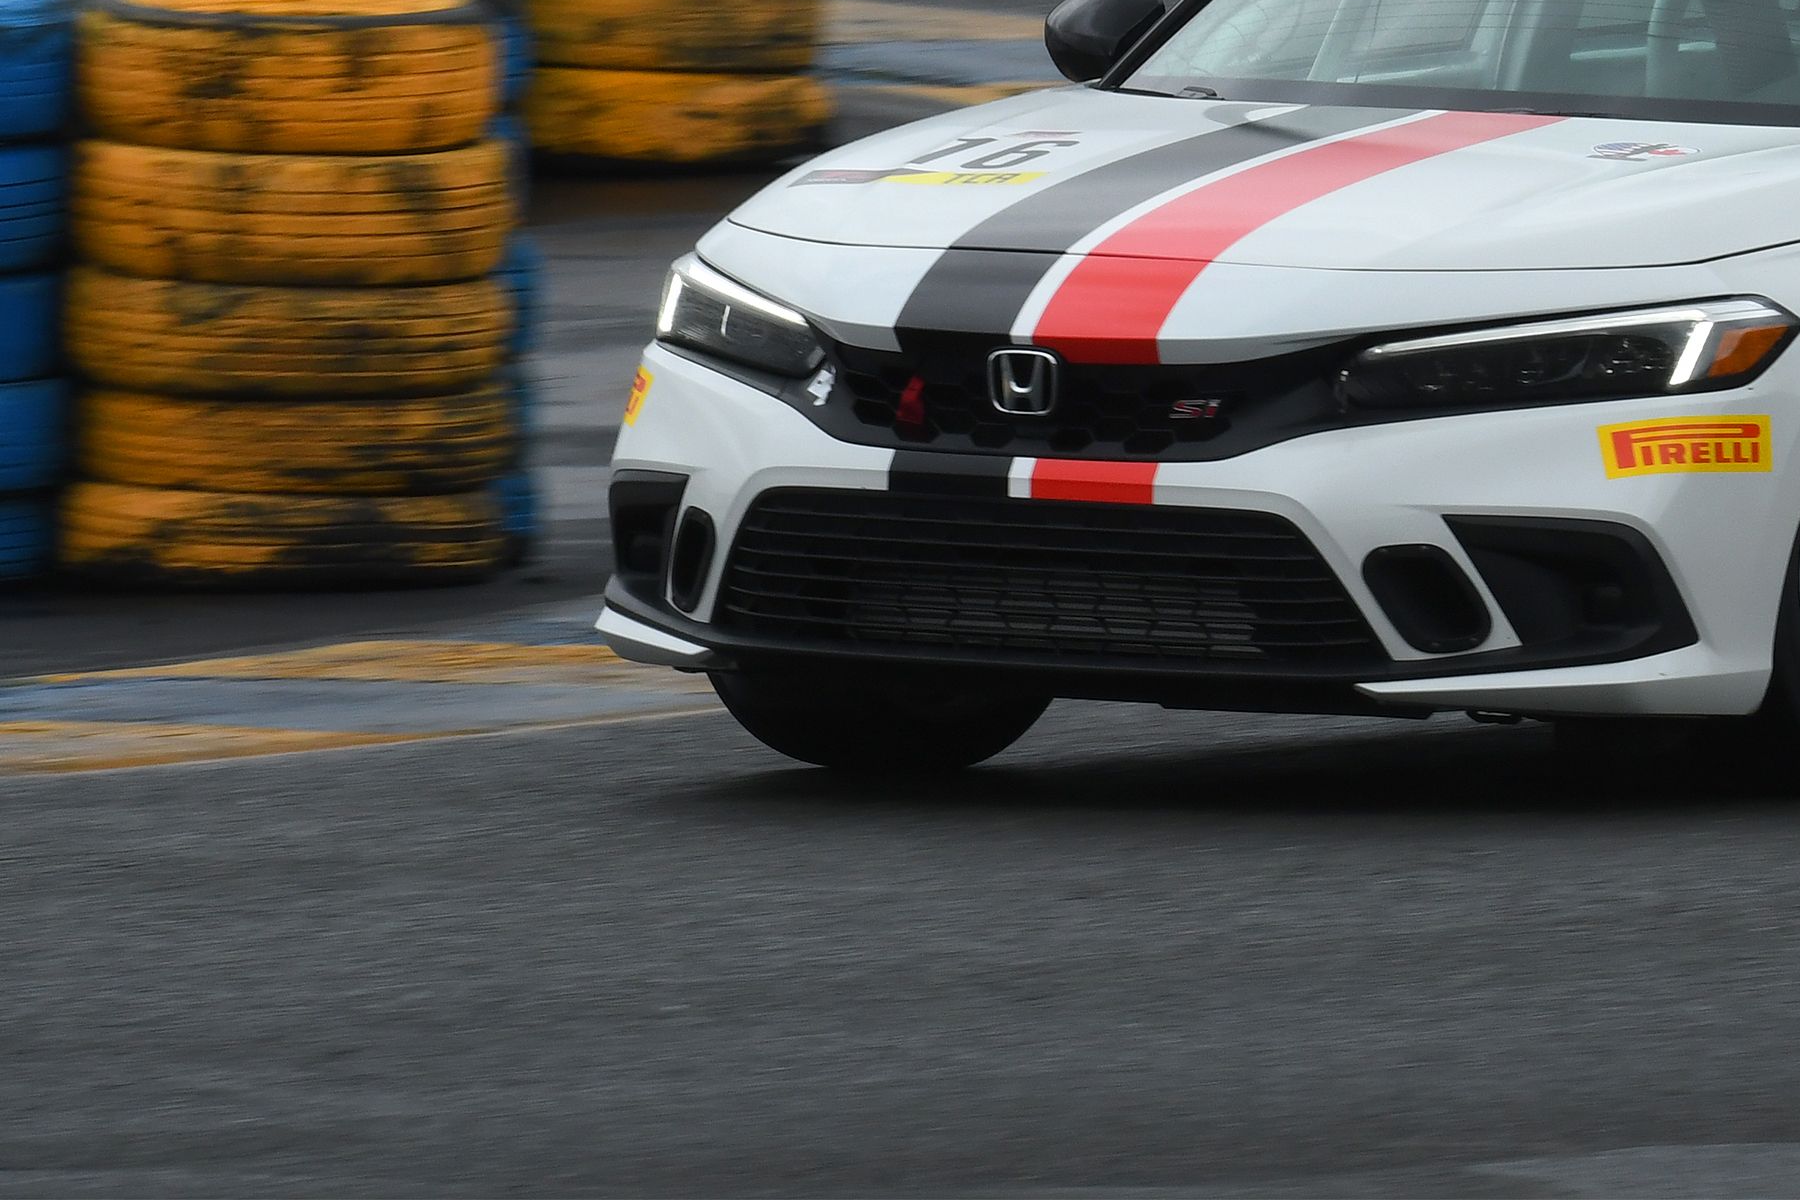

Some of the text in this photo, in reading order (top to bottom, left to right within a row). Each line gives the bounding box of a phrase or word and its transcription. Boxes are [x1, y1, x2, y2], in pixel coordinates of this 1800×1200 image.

[908, 137, 1081, 169] 16
[943, 172, 1022, 184] TCA
[1611, 423, 1761, 469] PIRELLI
